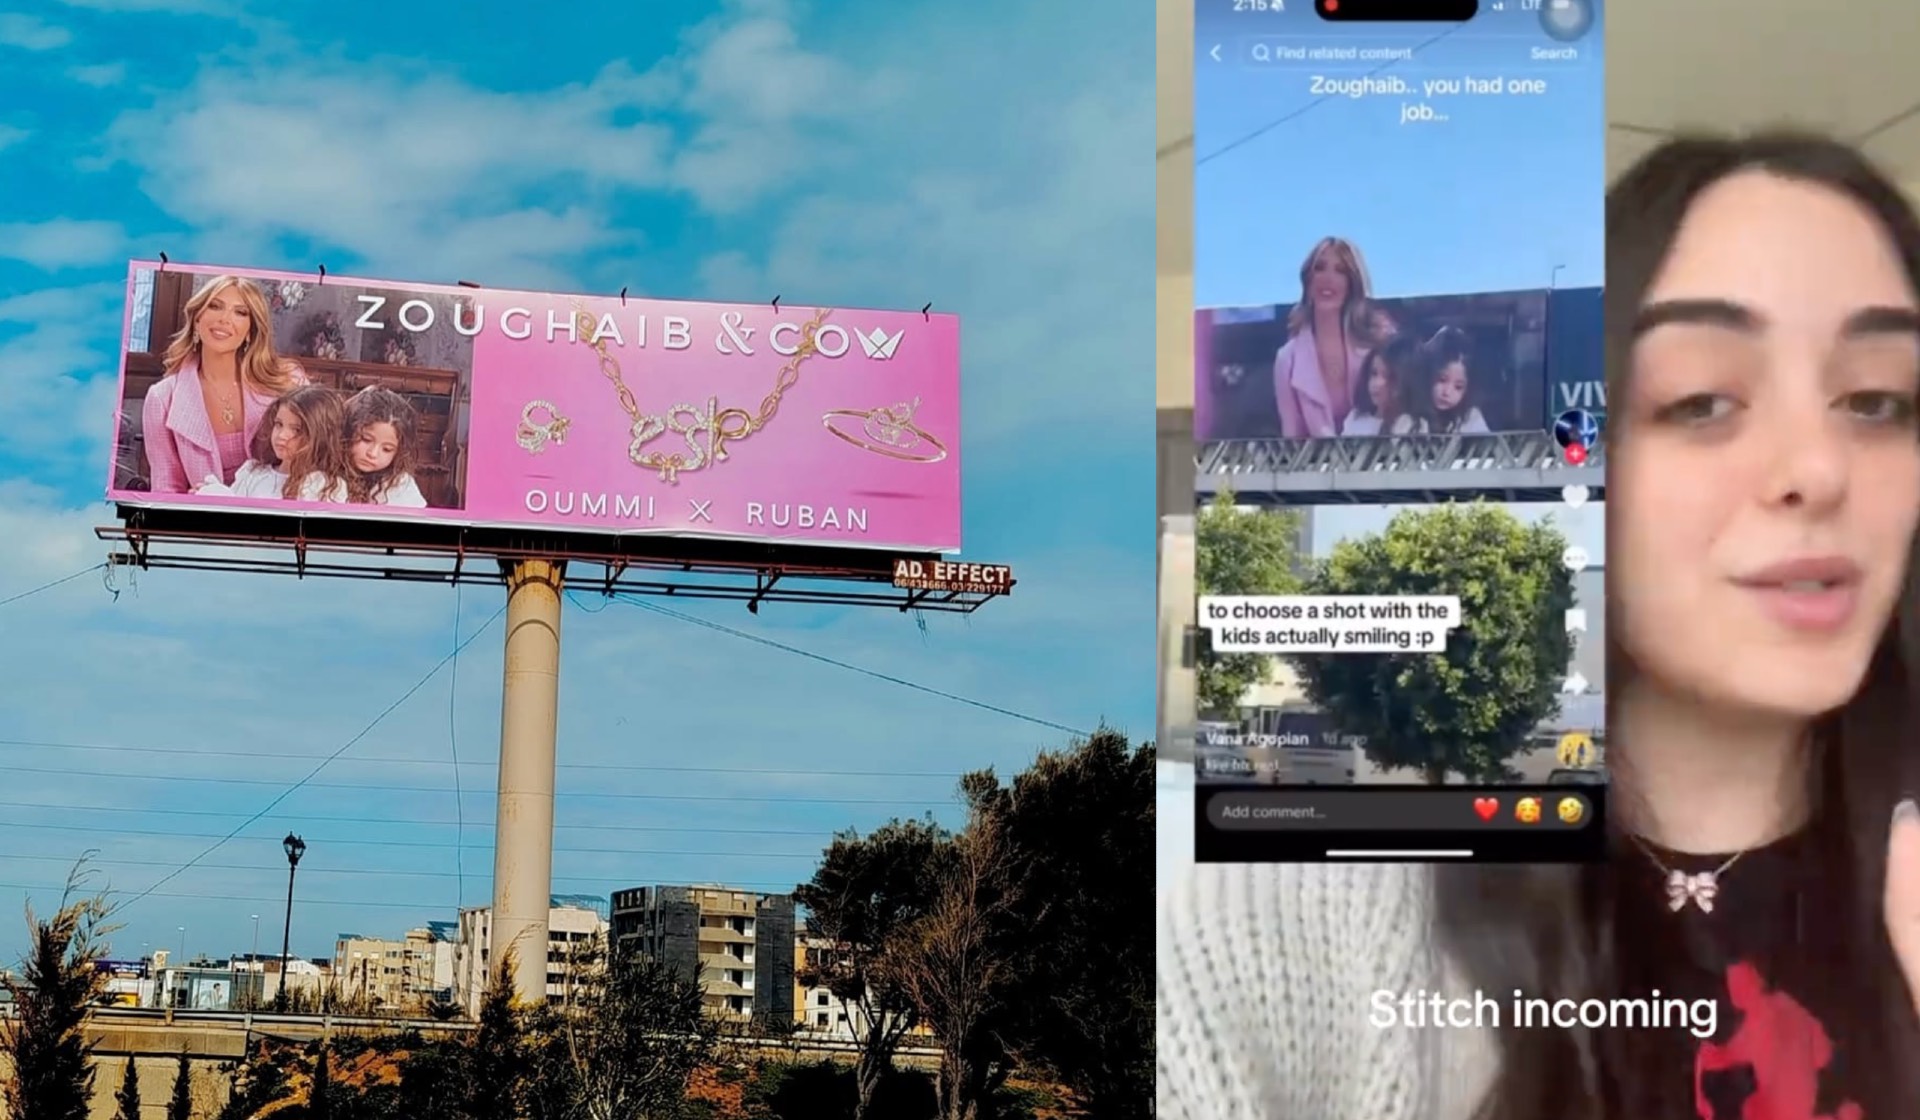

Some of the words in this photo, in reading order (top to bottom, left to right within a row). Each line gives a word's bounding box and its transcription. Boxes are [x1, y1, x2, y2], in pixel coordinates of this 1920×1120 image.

[1276, 46, 1306, 60] Find
[1308, 47, 1357, 60] related
[1359, 48, 1412, 60] content
[1531, 47, 1578, 60] Search
[1310, 76, 1418, 97] Zoughaib..
[1423, 80, 1461, 97] you
[1465, 77, 1503, 94] had
[1508, 80, 1546, 94] one
[1399, 103, 1450, 123] job...
[355, 294, 692, 350] ZOUGHAIB
[715, 311, 757, 355] &
[525, 488, 656, 520] OUMMI
[688, 499, 713, 522] X
[746, 502, 868, 532] RUBAN
[895, 560, 927, 578] AD.
[934, 561, 1009, 584] EFFECT
[1207, 603, 1228, 619] to
[1232, 602, 1303, 619] choose
[1307, 605, 1319, 619] a
[1323, 603, 1366, 619] shot
[1370, 602, 1412, 619] with
[1416, 603, 1449, 619] the
[1221, 628, 1261, 645] kids
[1265, 628, 1340, 648] actually
[1344, 628, 1411, 648] smiling
[1416, 631, 1435, 648] :p
[1205, 732, 1243, 745] Vana
[1246, 731, 1310, 748] Agopian
[1222, 806, 1250, 818] Add
[1252, 807, 1327, 818] comment...
